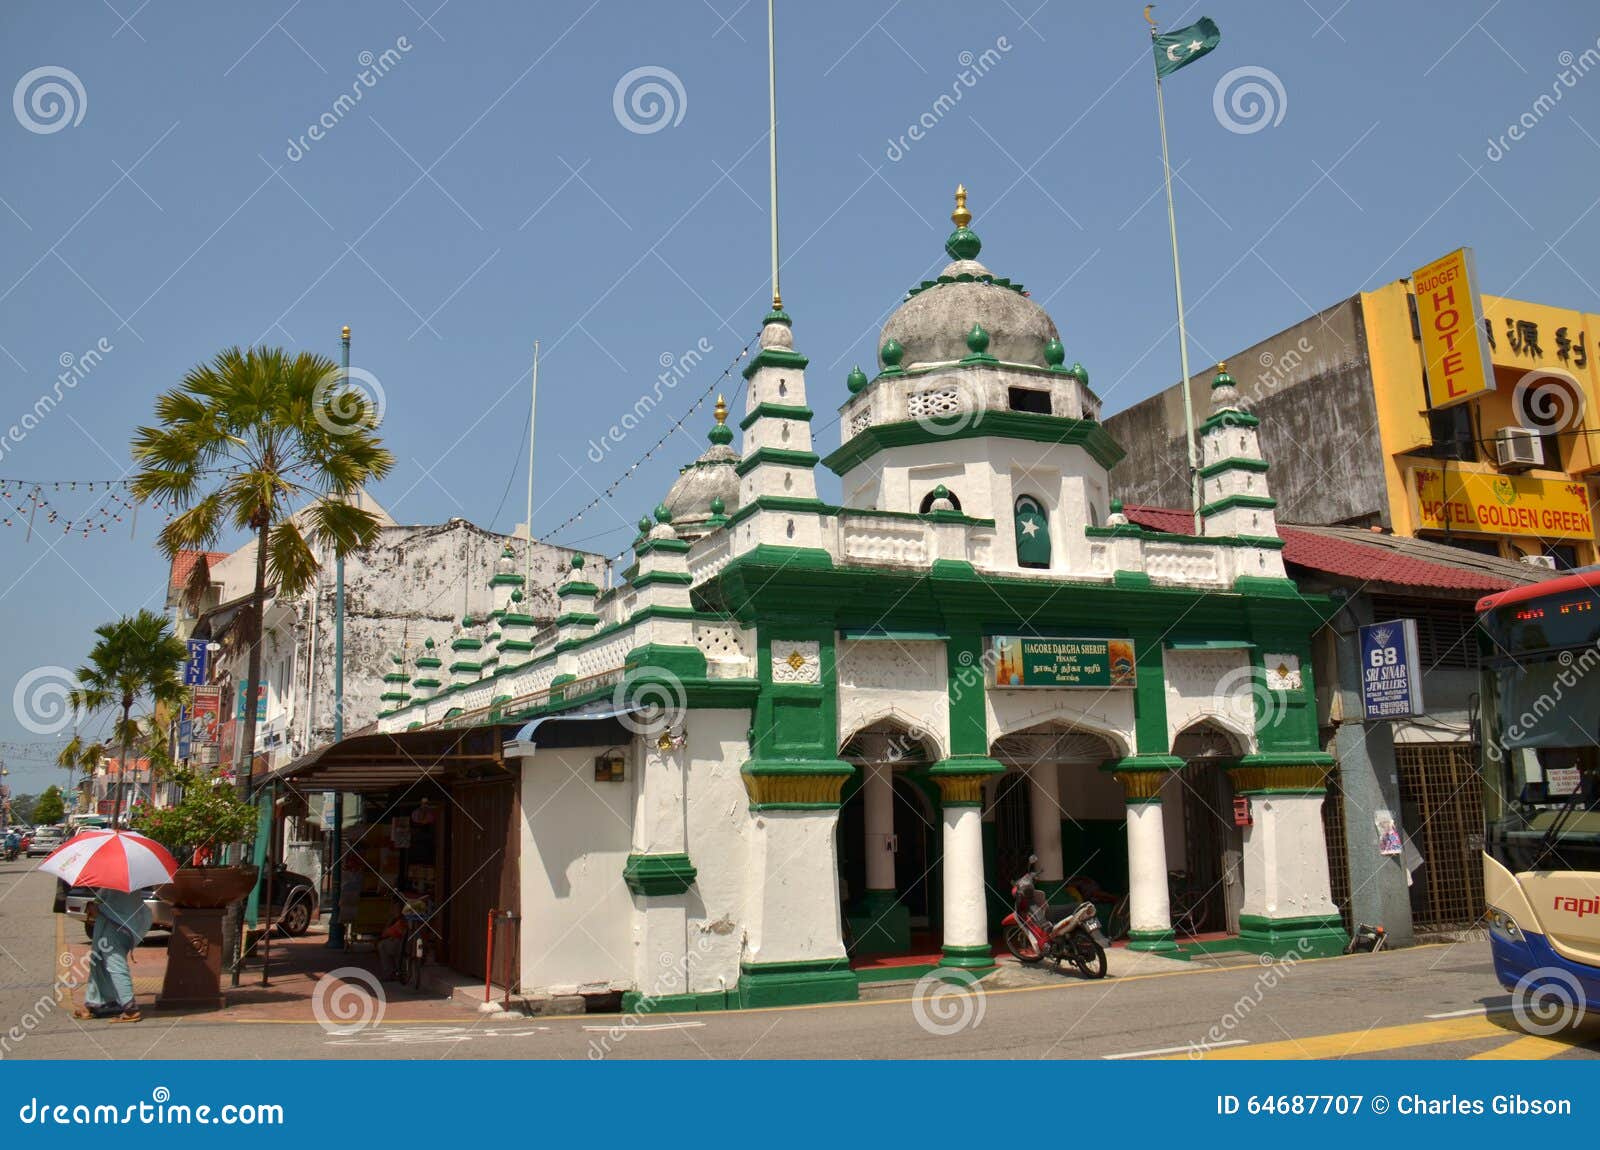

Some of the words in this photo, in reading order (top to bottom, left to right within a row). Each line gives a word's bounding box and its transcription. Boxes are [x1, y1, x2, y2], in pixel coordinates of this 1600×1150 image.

[1416, 265, 1459, 295] BUDGET
[1432, 286, 1467, 398] HOTEL
[1423, 500, 1475, 523] HOTEL
[1477, 504, 1538, 528] GOLDEN
[1542, 510, 1591, 532] GREEN
[1024, 644, 1052, 654] NAGORE
[1370, 646, 1398, 667] 68
[1366, 667, 1380, 682] SRI
[1381, 664, 1406, 680] SINAR
[1554, 896, 1600, 918] rapi
